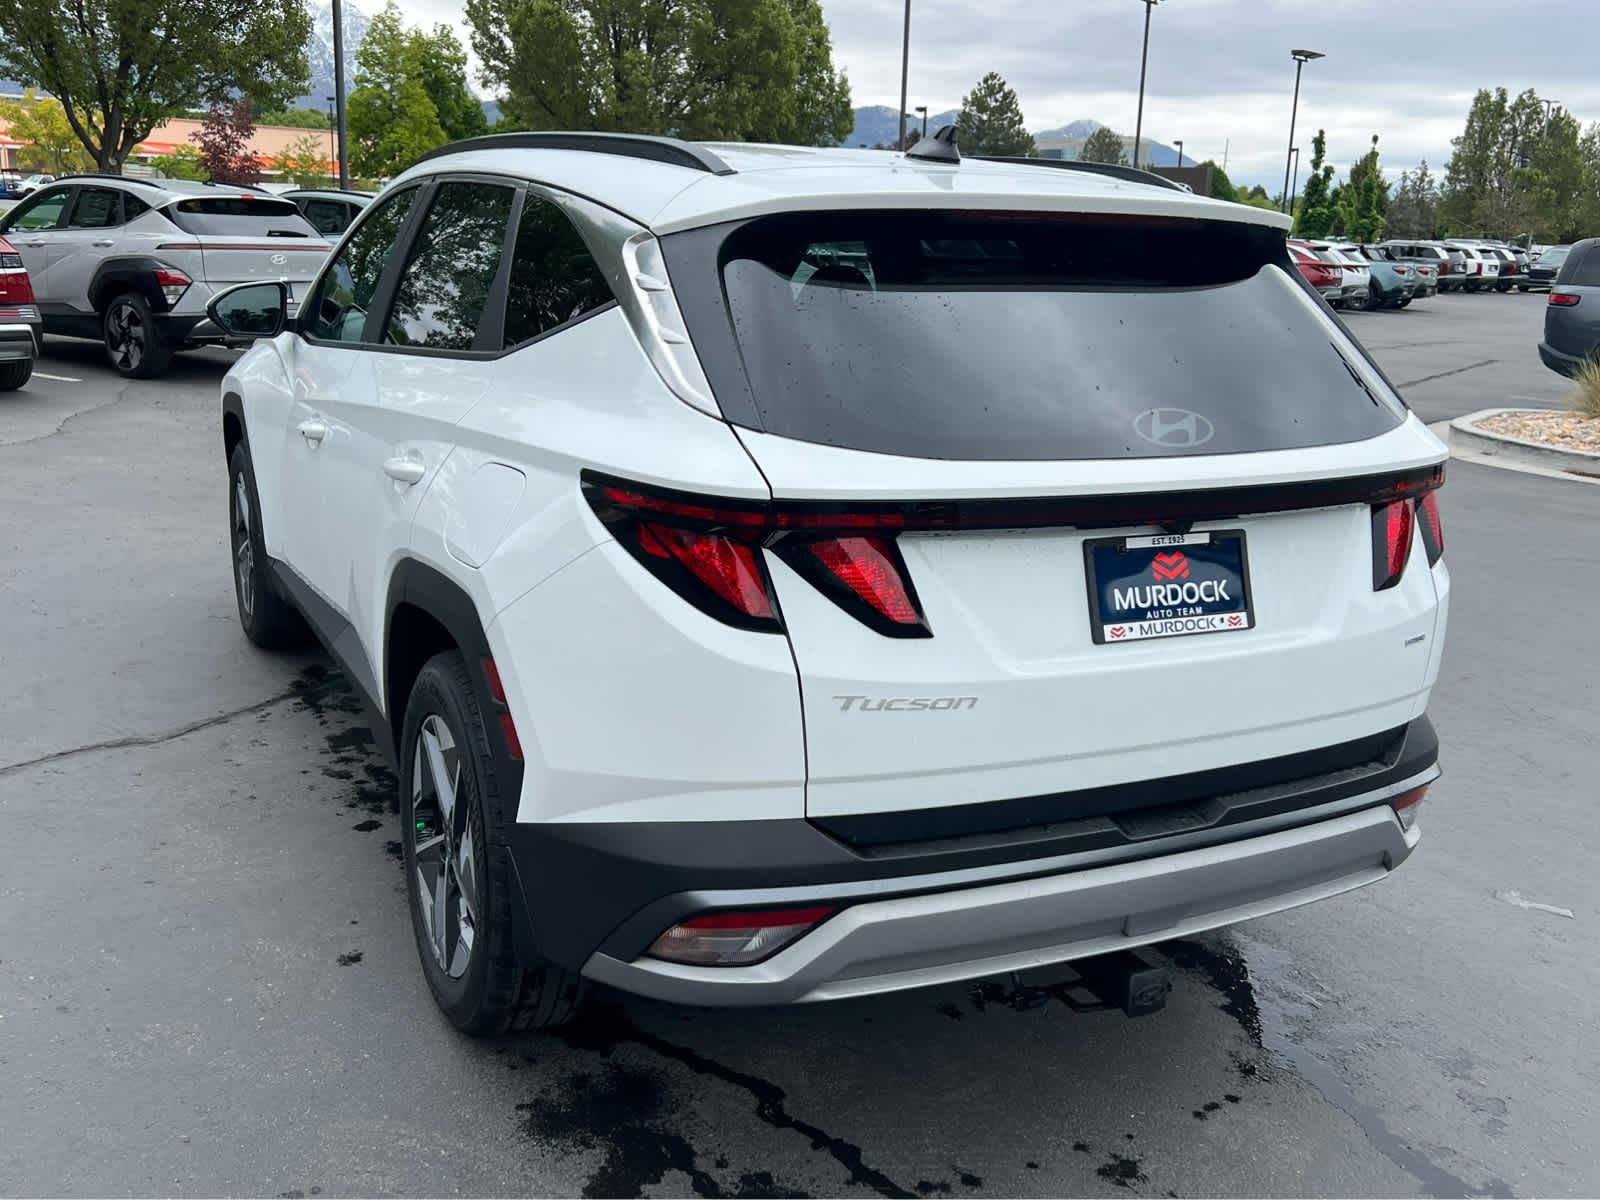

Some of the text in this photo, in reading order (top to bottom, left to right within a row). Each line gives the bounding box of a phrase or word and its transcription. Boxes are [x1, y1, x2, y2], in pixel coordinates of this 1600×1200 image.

[1152, 535, 1185, 546] EST. 1925
[1113, 579, 1230, 611] MURDOCK
[1146, 606, 1203, 619] AUTO TEAM
[1139, 618, 1217, 636] MURDOCK
[832, 695, 979, 713] Tucson
